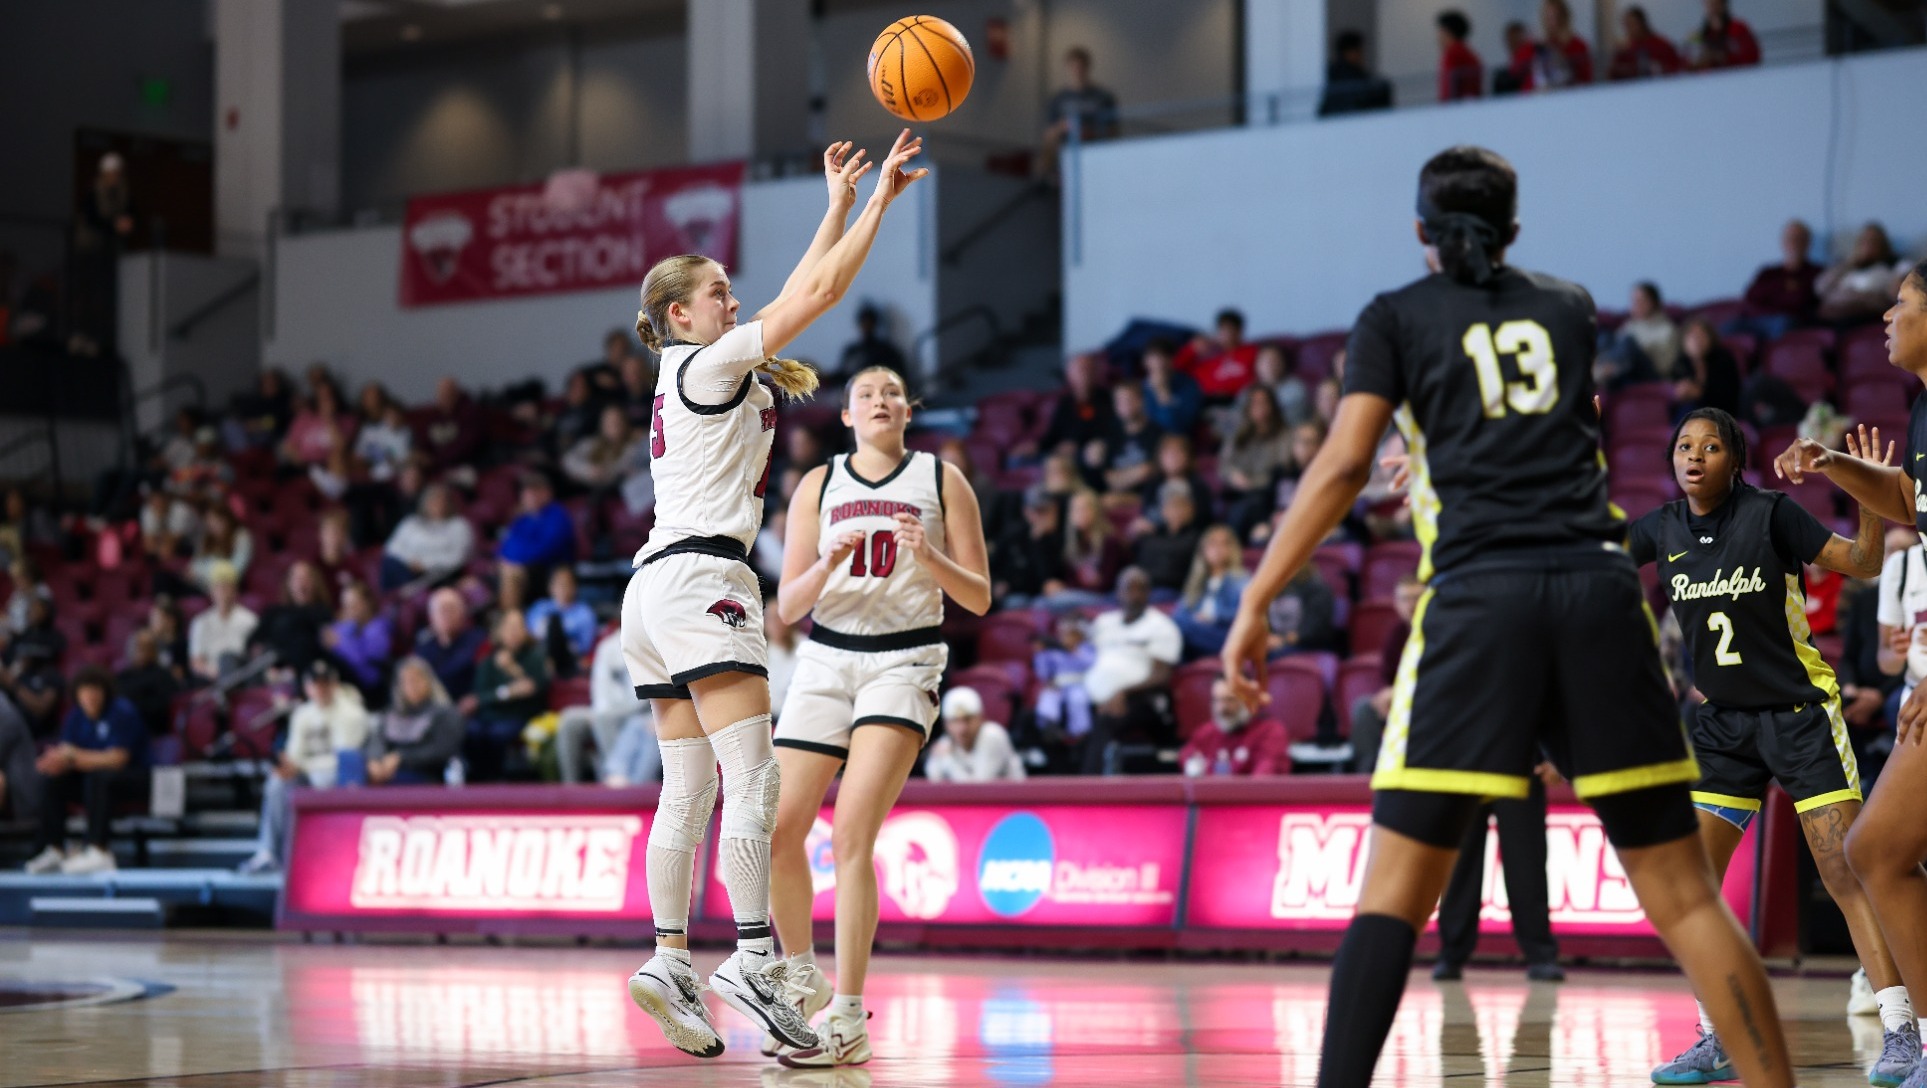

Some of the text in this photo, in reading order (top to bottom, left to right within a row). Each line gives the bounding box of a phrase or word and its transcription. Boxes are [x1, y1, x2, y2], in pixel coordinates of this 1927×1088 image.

[490, 232, 646, 290] SECTION
[1462, 319, 1559, 419] 13
[849, 530, 898, 578] 10
[1671, 566, 1766, 601] Randolph
[1707, 612, 1743, 666] 2
[352, 816, 638, 911] ROANOKE
[1055, 861, 1137, 889] Division
